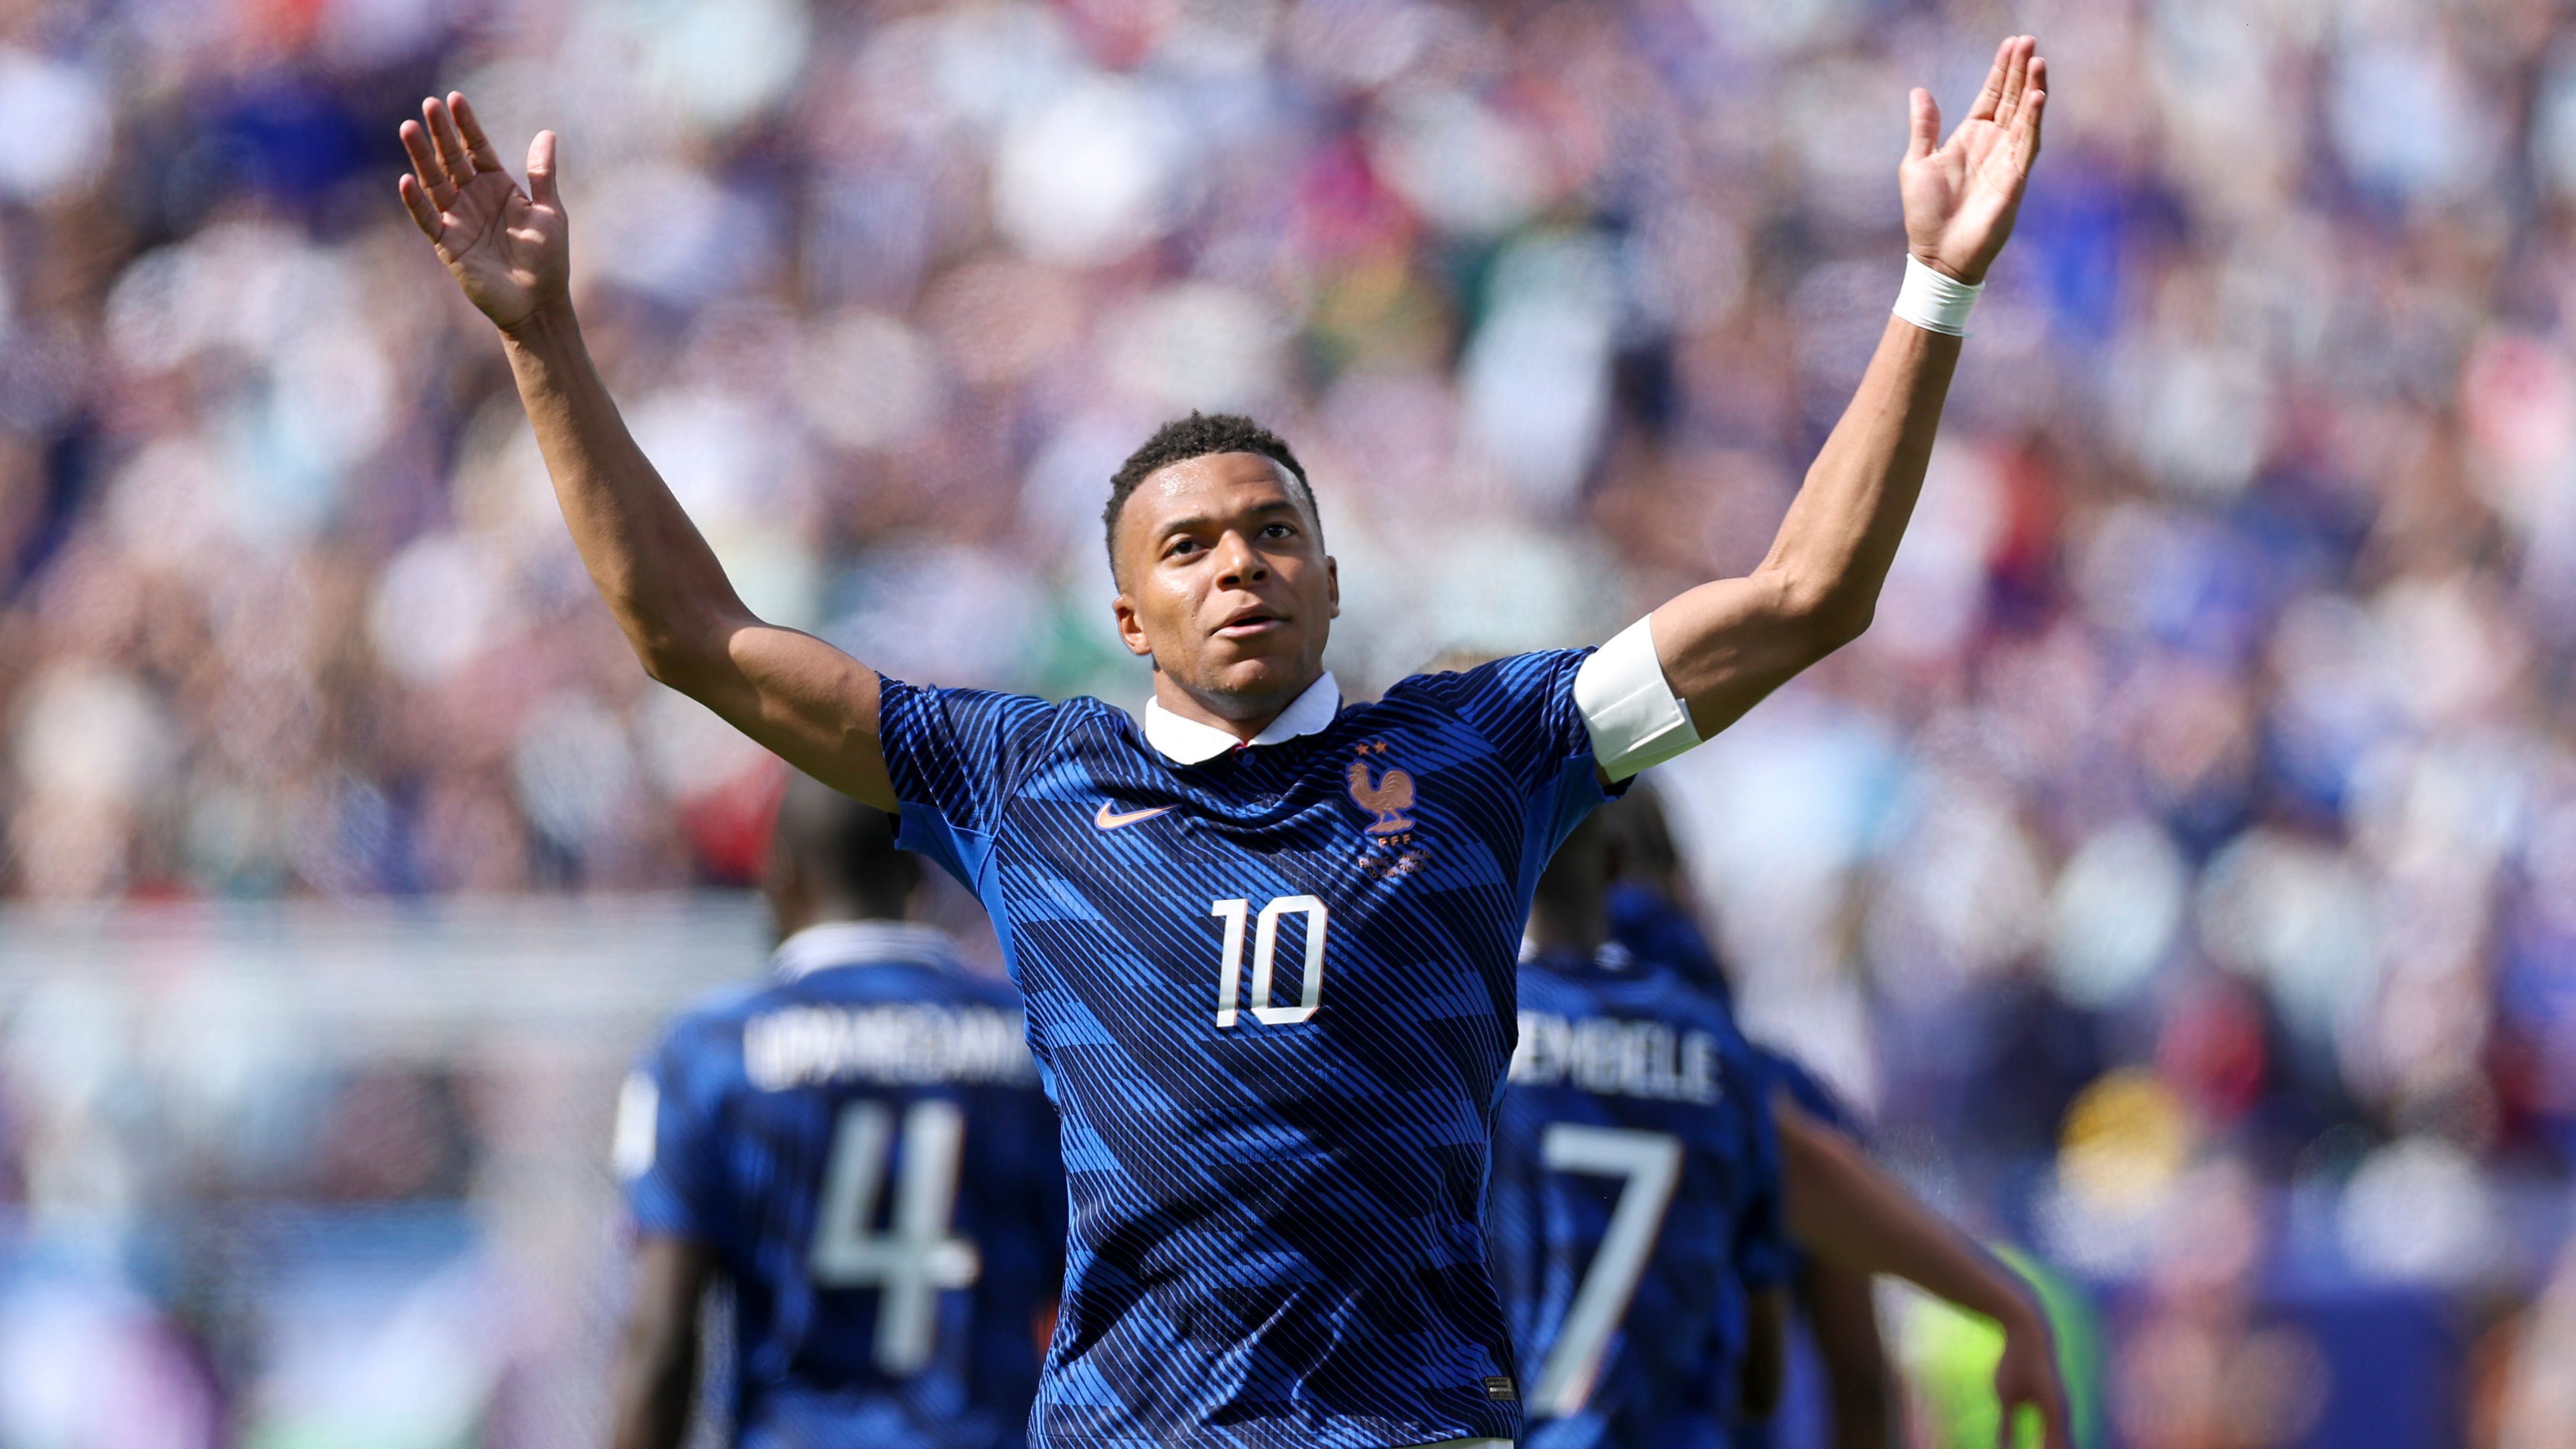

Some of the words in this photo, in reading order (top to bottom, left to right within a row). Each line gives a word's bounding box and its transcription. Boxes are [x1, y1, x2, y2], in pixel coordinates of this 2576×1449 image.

[1211, 895, 1329, 1028] 10
[1507, 1009, 1721, 1105] EMBELE
[810, 1099, 980, 1374] 4
[1528, 1121, 1684, 1418] 7
